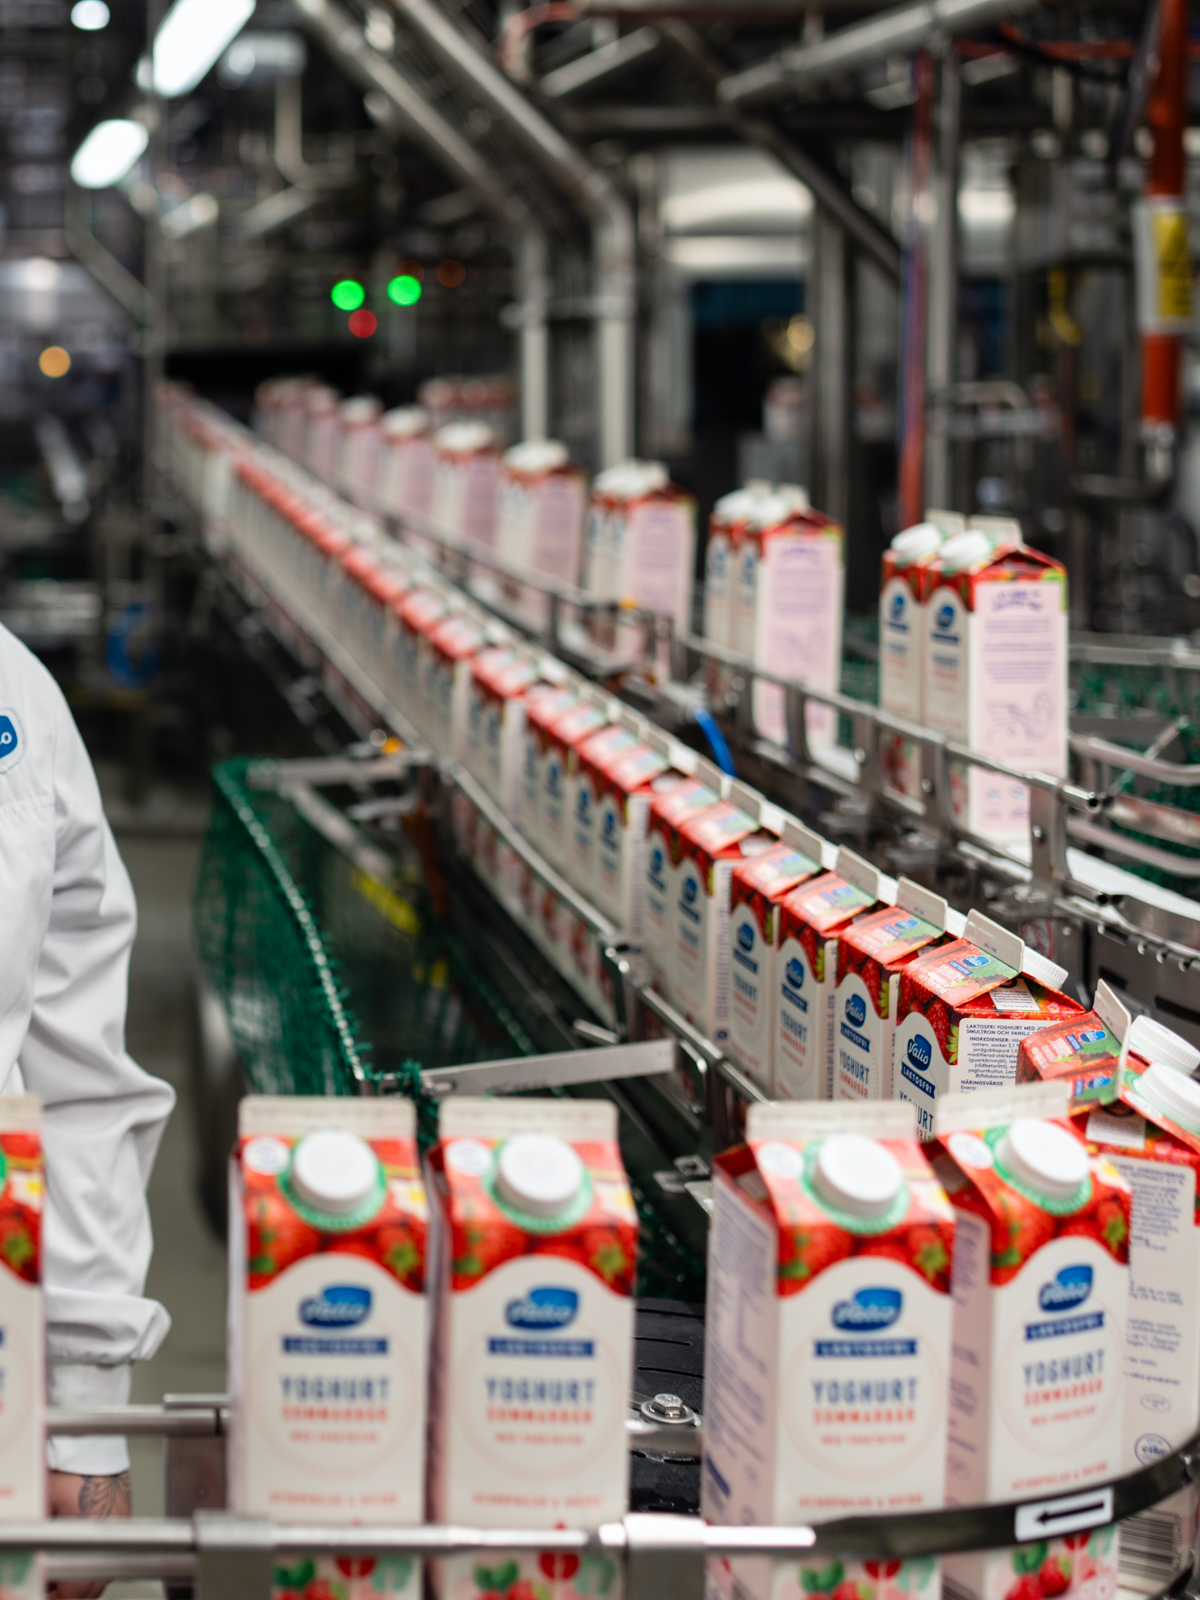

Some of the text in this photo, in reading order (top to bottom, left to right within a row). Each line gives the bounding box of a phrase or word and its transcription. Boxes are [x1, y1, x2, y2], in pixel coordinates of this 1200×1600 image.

[846, 1001, 864, 1022] Valio
[840, 1049, 869, 1085] YOGHURT
[908, 1042, 929, 1065] Valio
[903, 1066, 932, 1092] LAKTOSFRI
[1023, 1350, 1104, 1386] YOGHURT
[813, 1378, 917, 1406] YOGHURT
